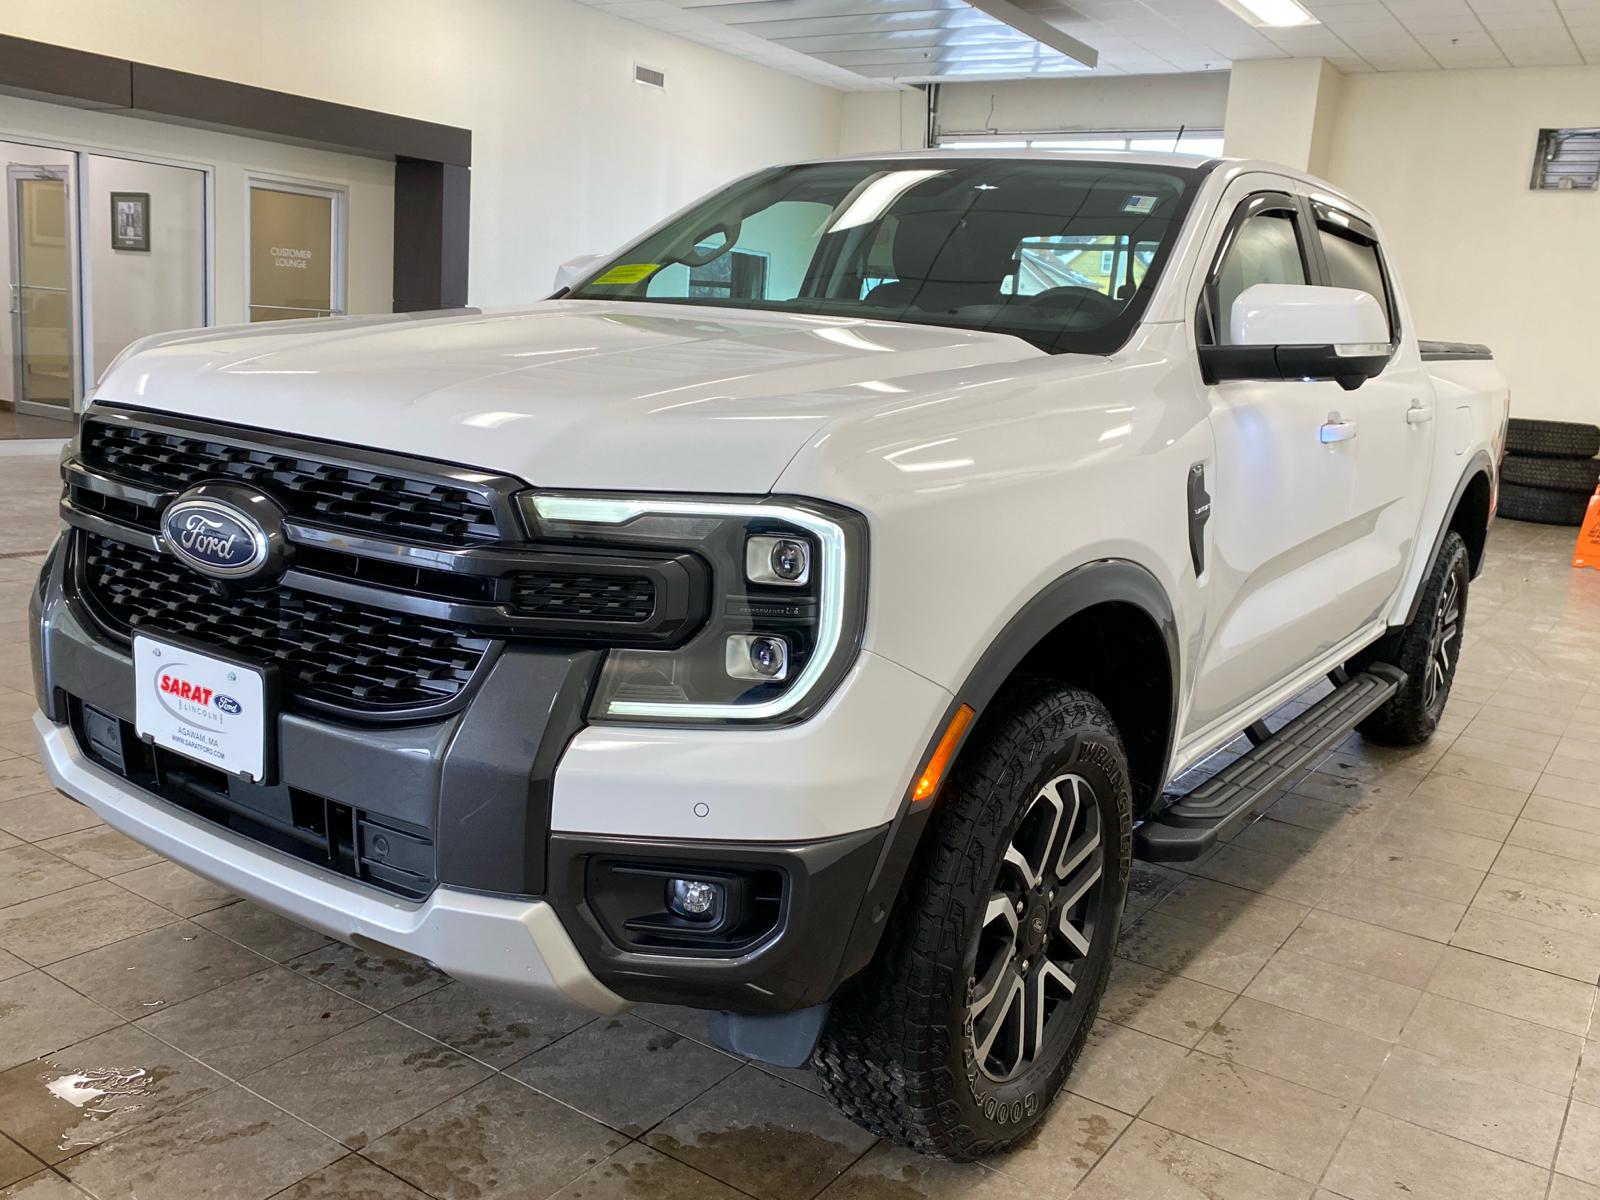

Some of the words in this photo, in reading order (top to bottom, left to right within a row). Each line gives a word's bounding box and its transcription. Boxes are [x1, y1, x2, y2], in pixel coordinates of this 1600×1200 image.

[270, 246, 312, 260] CUSTOMER
[275, 257, 307, 269] LOUNGE
[181, 514, 236, 559] Ford
[159, 673, 213, 707] SARAT
[217, 696, 238, 714] Ford
[184, 702, 218, 721] LINCOLN
[171, 733, 226, 760] WWW.SARATFORD.COM
[177, 726, 207, 745] AGAWAM,
[208, 737, 219, 748] MA
[1078, 740, 1132, 883] WRANGLER
